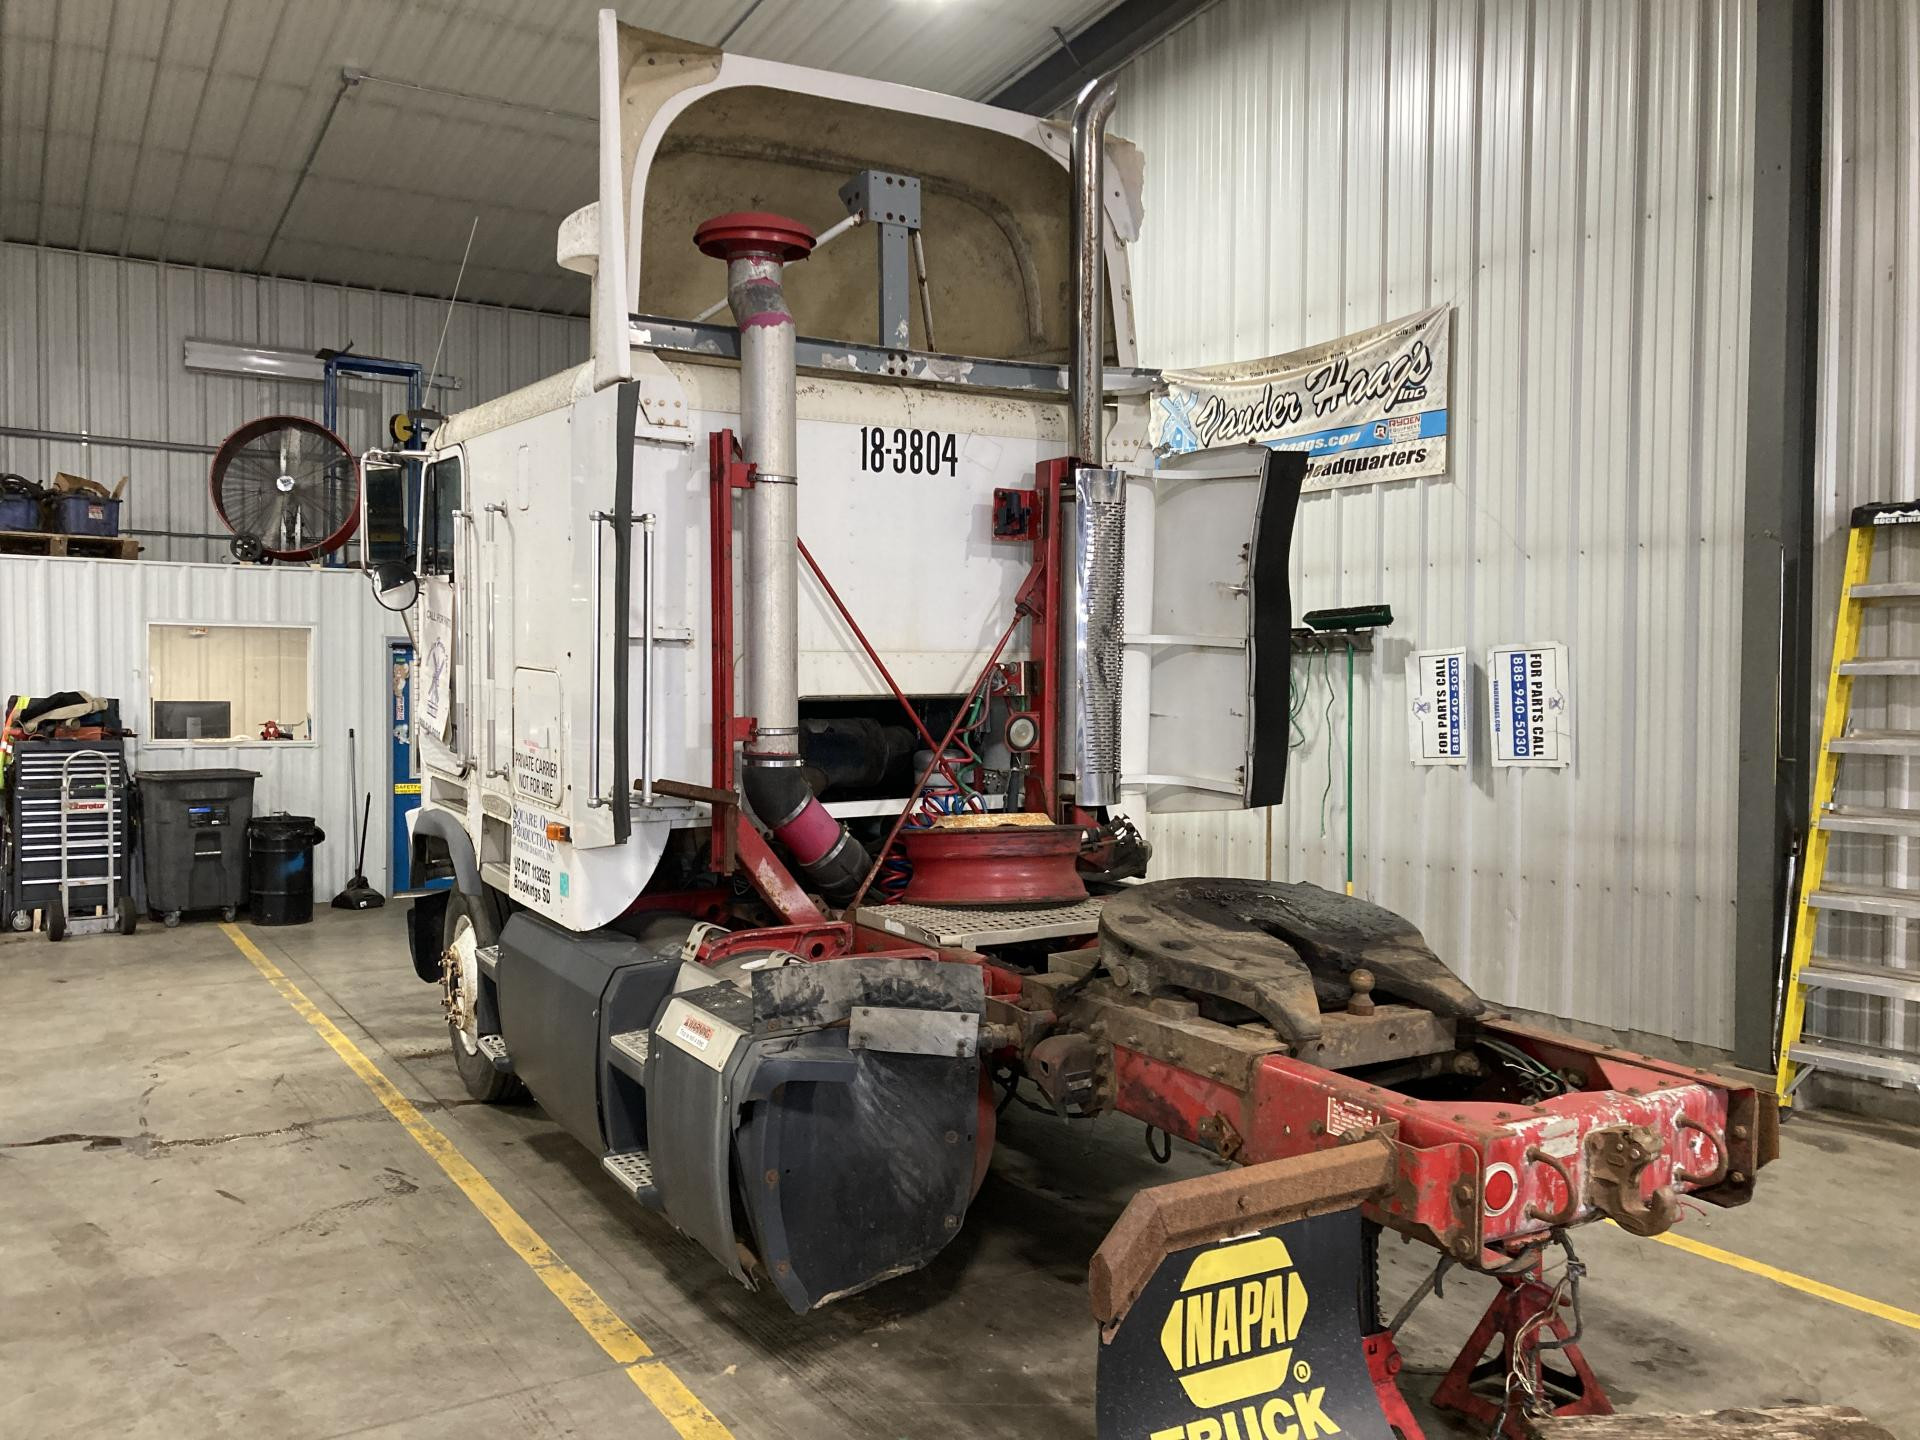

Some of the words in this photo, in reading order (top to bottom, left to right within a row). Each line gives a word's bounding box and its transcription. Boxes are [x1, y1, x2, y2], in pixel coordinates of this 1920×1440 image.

[1196, 383, 1302, 448] Vander
[1305, 341, 1432, 413] Haag's
[860, 426, 958, 477] 18-3804
[1304, 448, 1427, 479] Headquarters
[1436, 658, 1447, 687] CALL
[1530, 653, 1543, 677] FOR
[1437, 689, 1447, 728] PARTS
[1450, 659, 1460, 752] 888-940-5030
[1513, 656, 1527, 755] 888-940-5030
[1531, 681, 1544, 723] PARTS
[1438, 727, 1448, 754] FOR
[1532, 727, 1545, 757] CALL
[515, 752, 534, 771] PRIVATE
[536, 758, 557, 779] CARRIER
[518, 773, 529, 790] NOT
[530, 777, 540, 795] FOR
[541, 780, 553, 799] HIRE
[513, 804, 538, 829] SQUARE
[514, 856, 521, 872] US
[521, 860, 531, 876] DOT
[513, 874, 541, 902] Brookings
[542, 887, 551, 904] SD
[1186, 1275, 1286, 1368] NAPA
[1150, 1386, 1341, 1440] UCK
